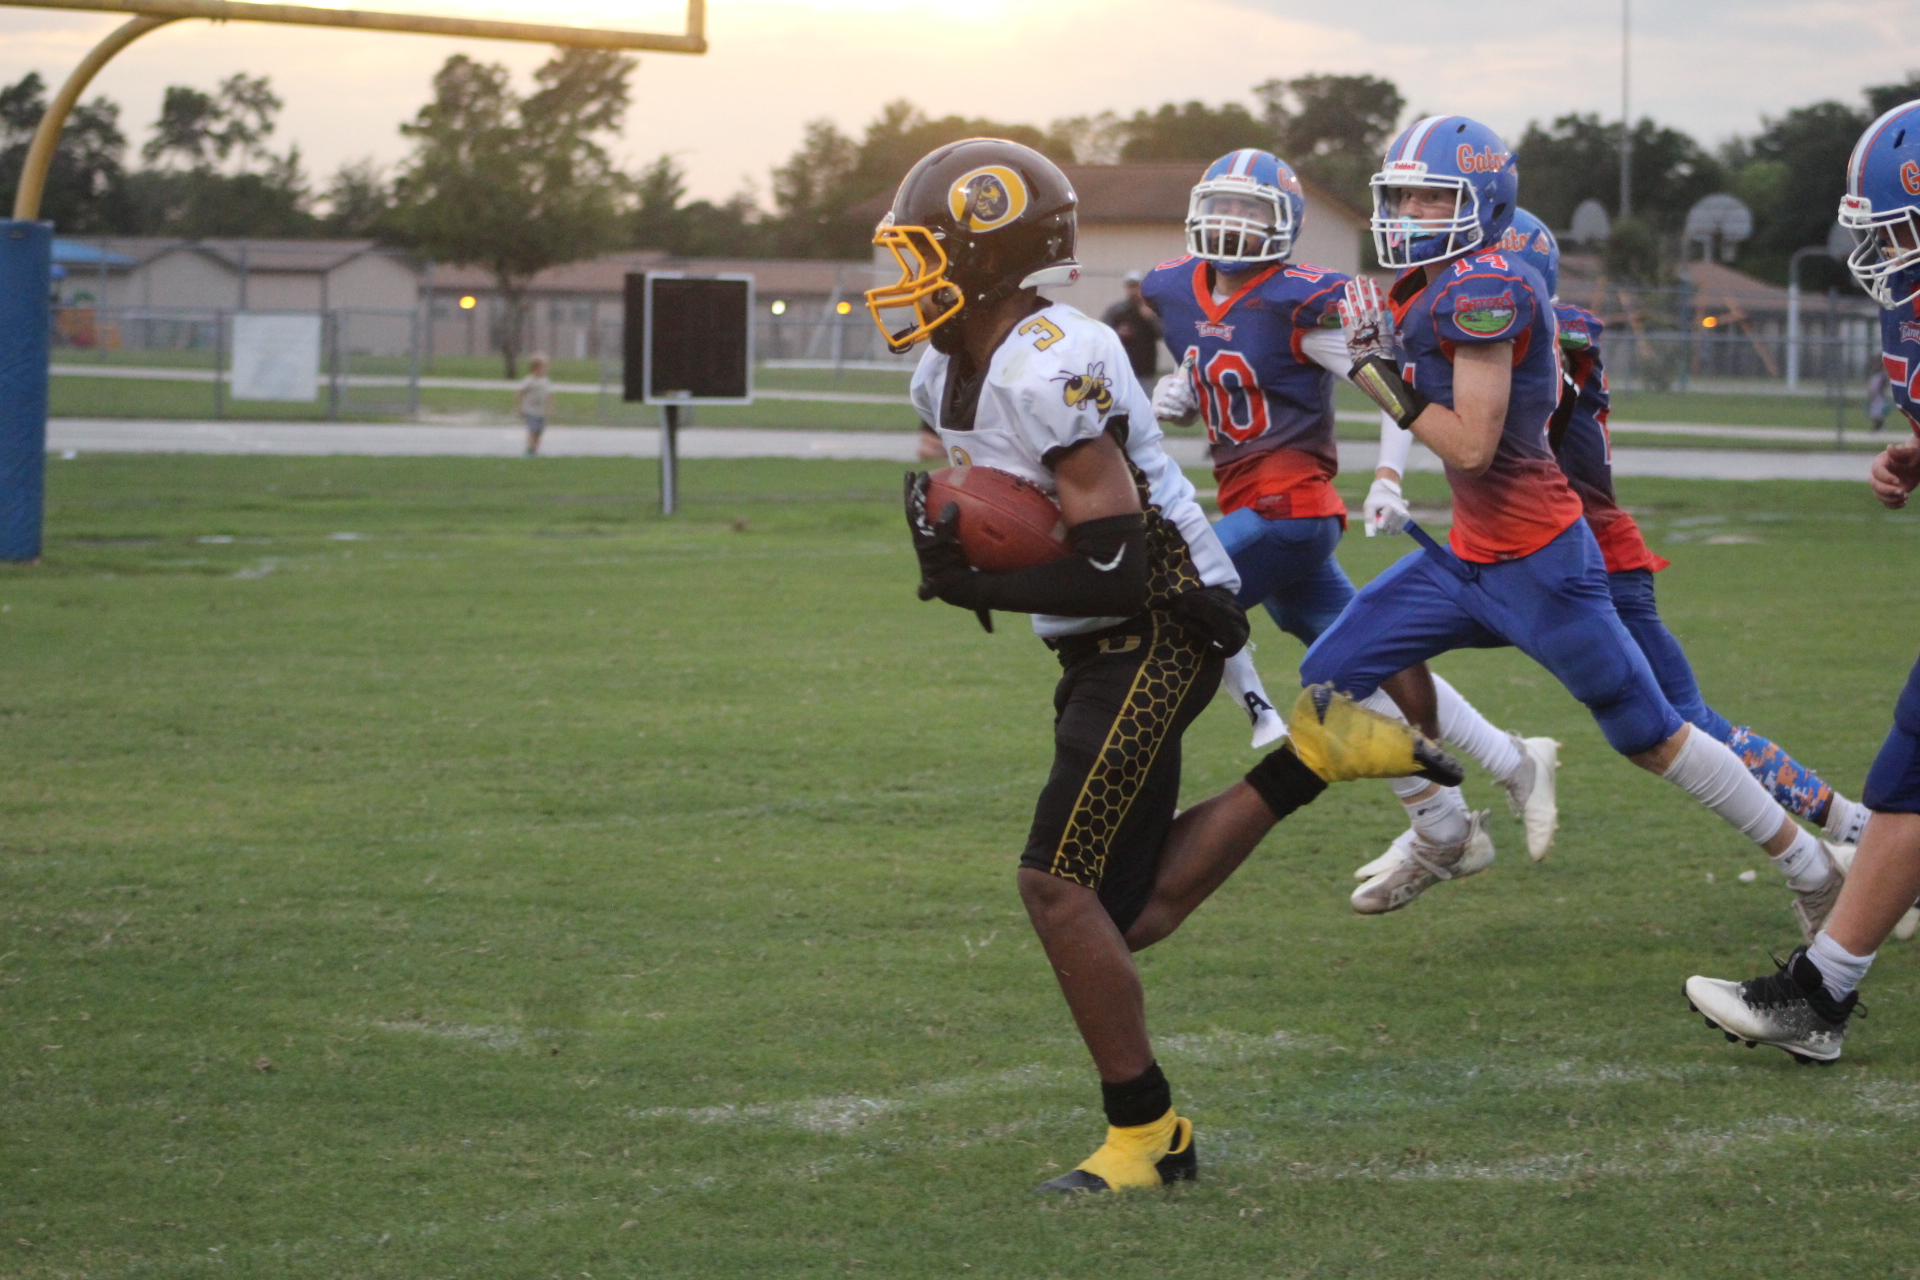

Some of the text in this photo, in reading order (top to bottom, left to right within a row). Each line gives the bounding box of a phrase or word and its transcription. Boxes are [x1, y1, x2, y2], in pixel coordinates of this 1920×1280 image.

[1451, 253, 1508, 277] 14
[1018, 315, 1066, 352] 3
[1184, 345, 1271, 445] 10
[1244, 690, 1274, 728] A
